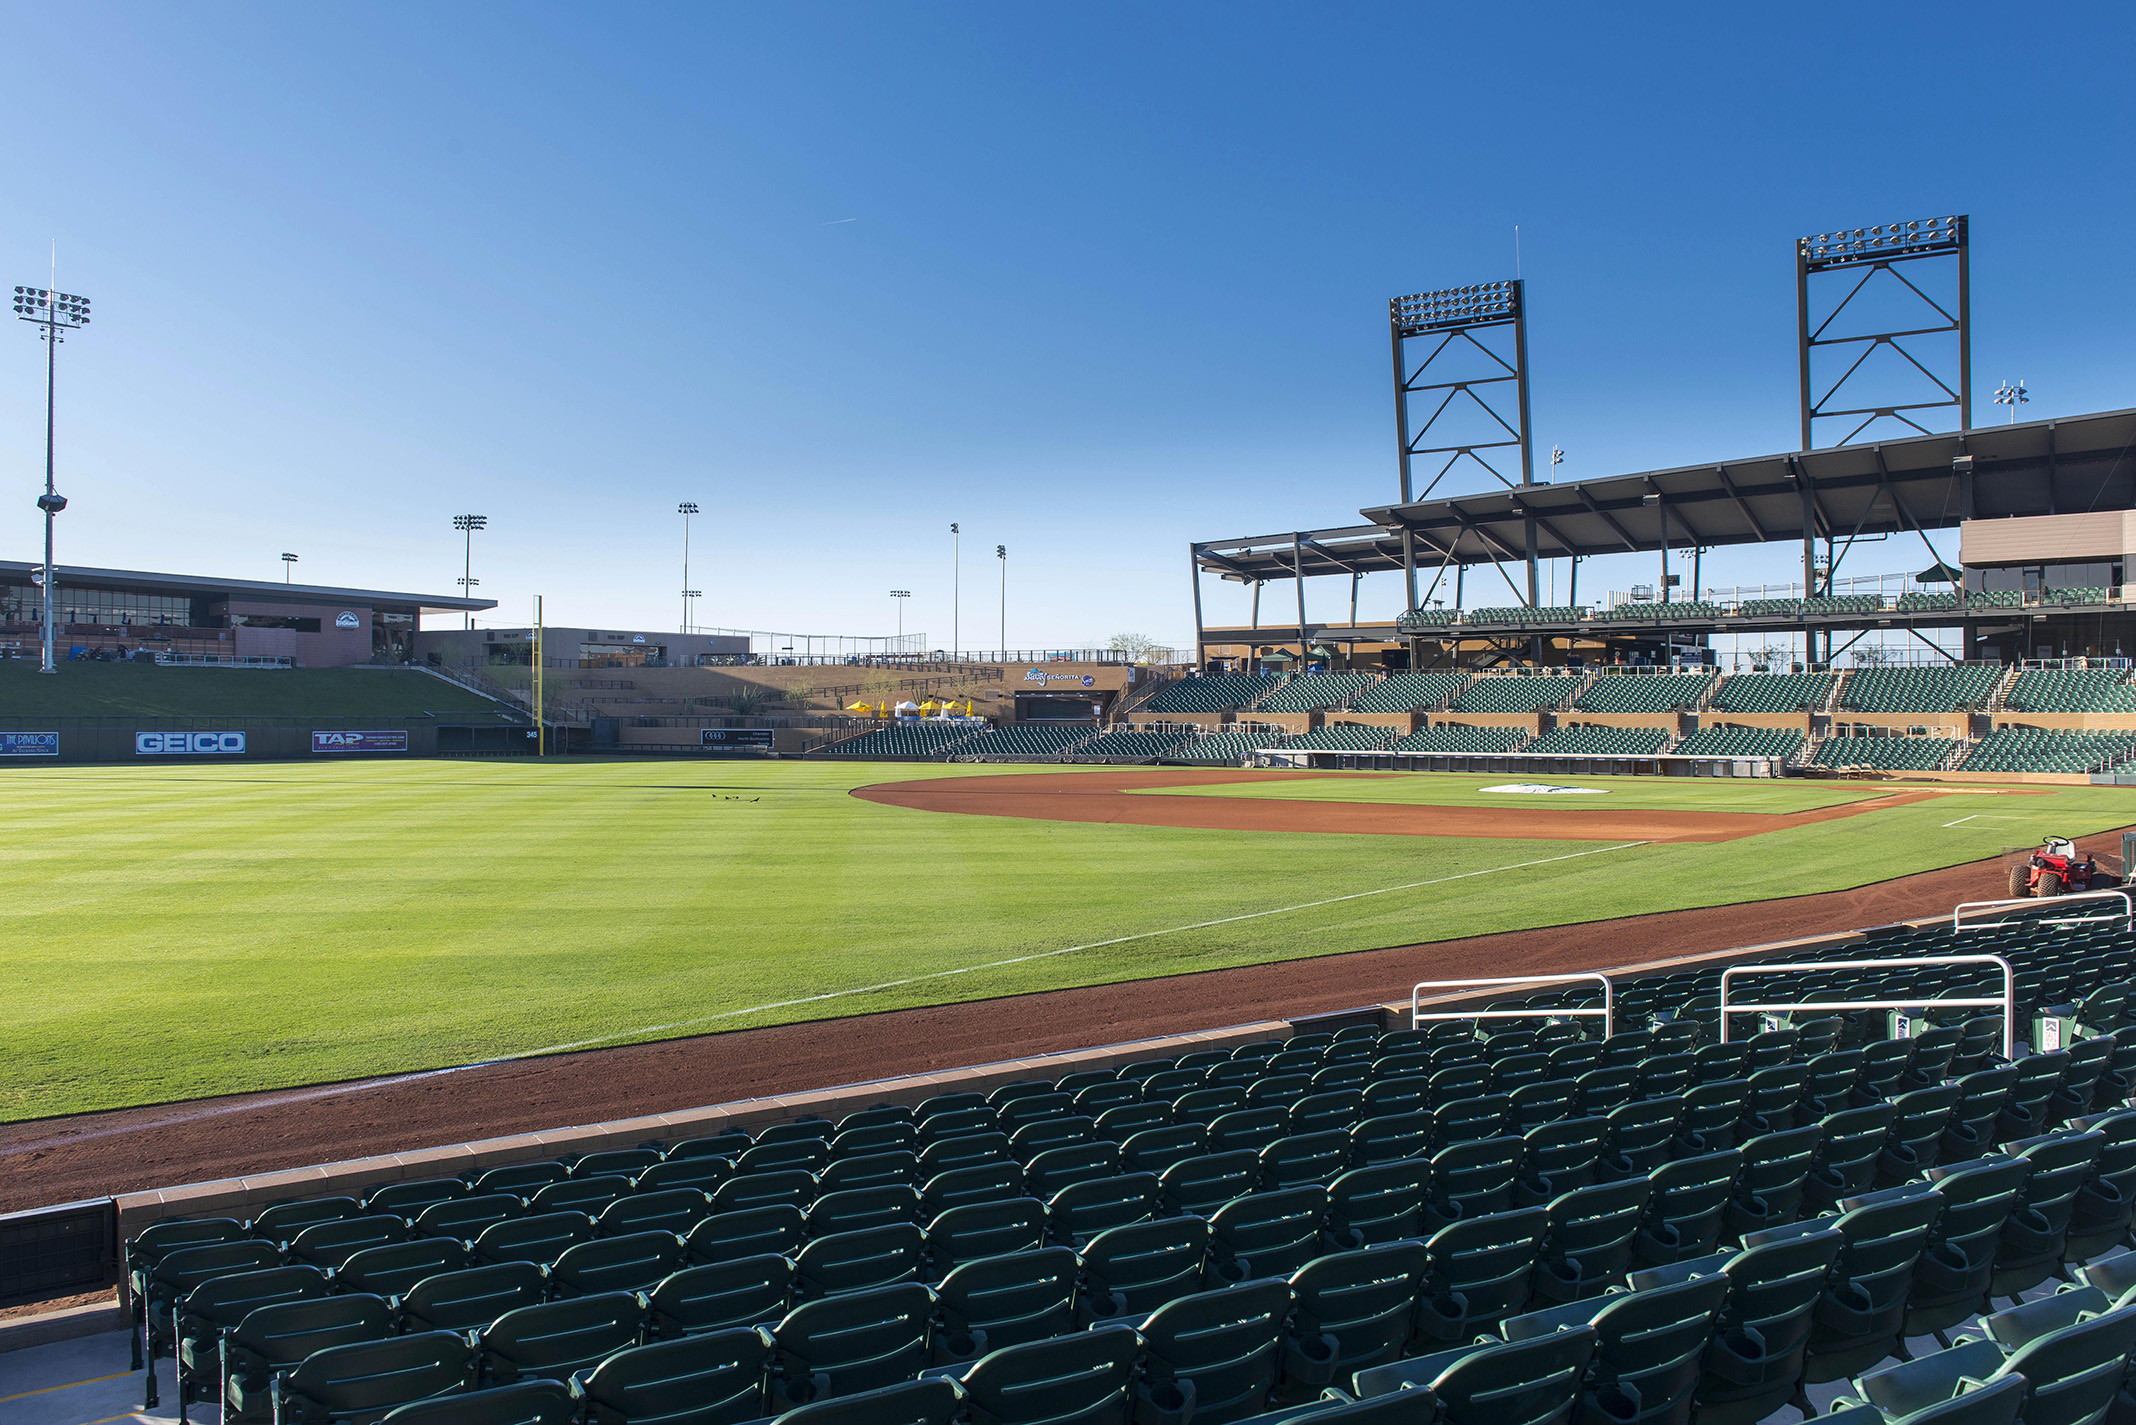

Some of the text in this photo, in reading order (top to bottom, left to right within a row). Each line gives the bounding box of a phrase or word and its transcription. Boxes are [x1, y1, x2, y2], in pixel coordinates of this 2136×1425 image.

[6, 734, 56, 745] THE PAVILIONS
[138, 733, 244, 752] GEICO
[314, 733, 364, 744] TAP
